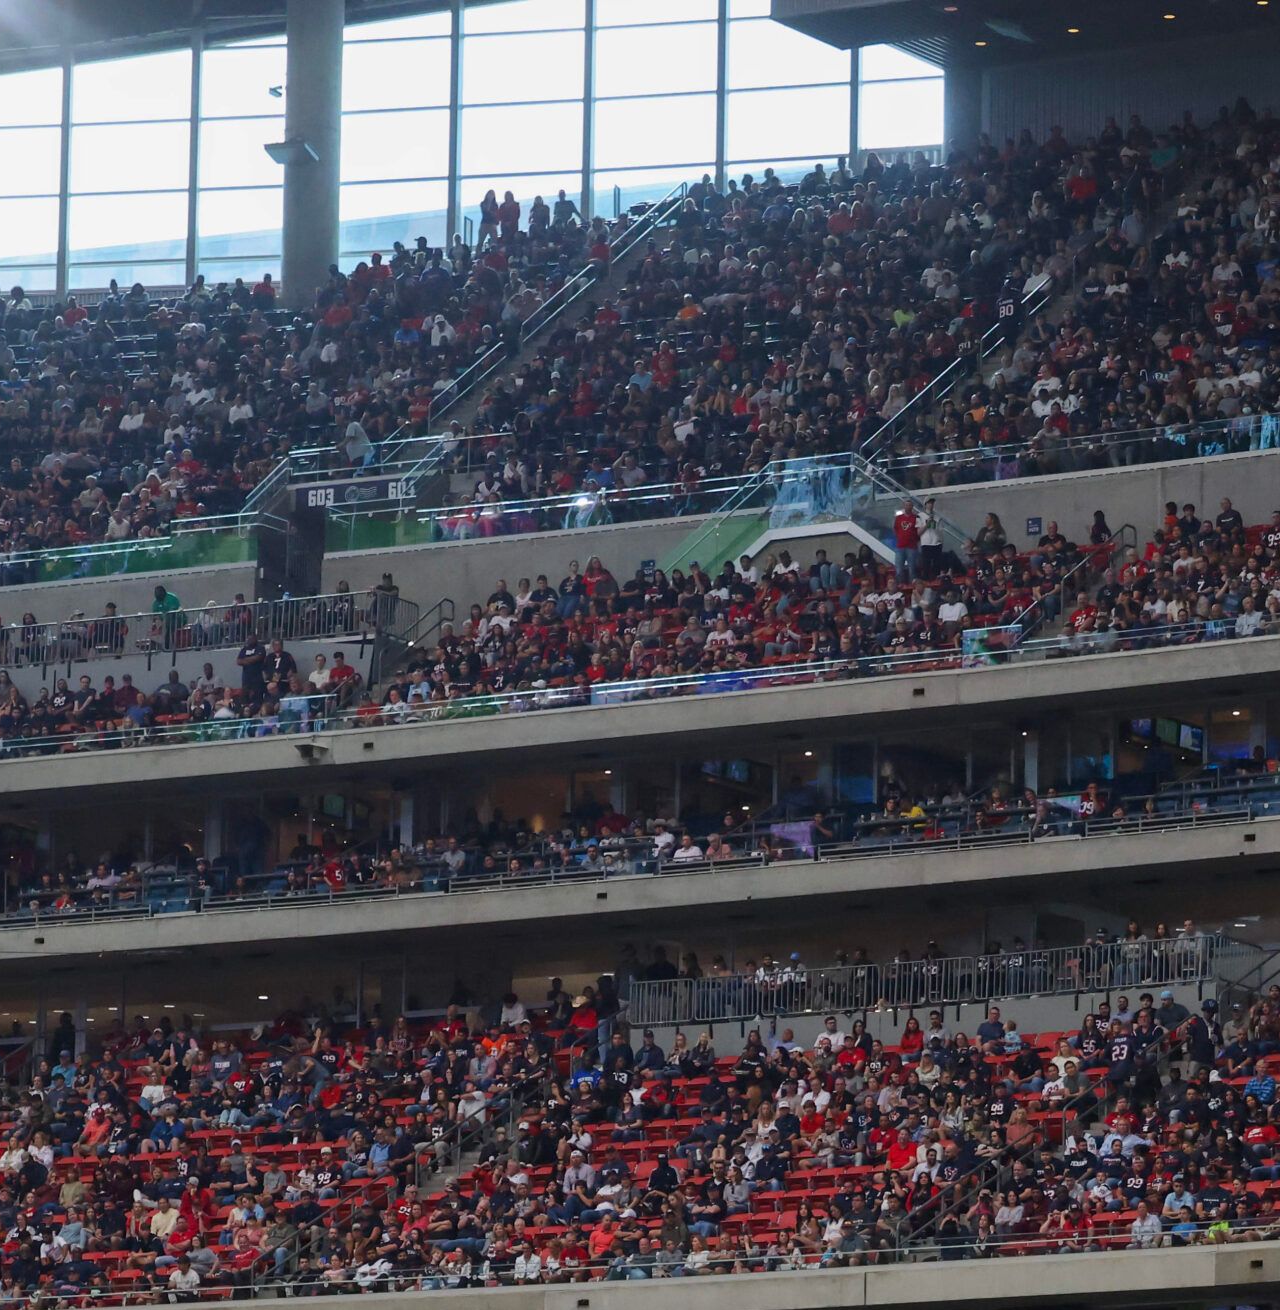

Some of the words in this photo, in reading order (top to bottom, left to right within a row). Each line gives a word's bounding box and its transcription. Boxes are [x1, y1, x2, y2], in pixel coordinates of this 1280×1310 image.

[308, 488, 335, 507] 603
[273, 657, 282, 668] 7
[1083, 1040, 1096, 1053] 56
[1111, 1044, 1128, 1061] 23
